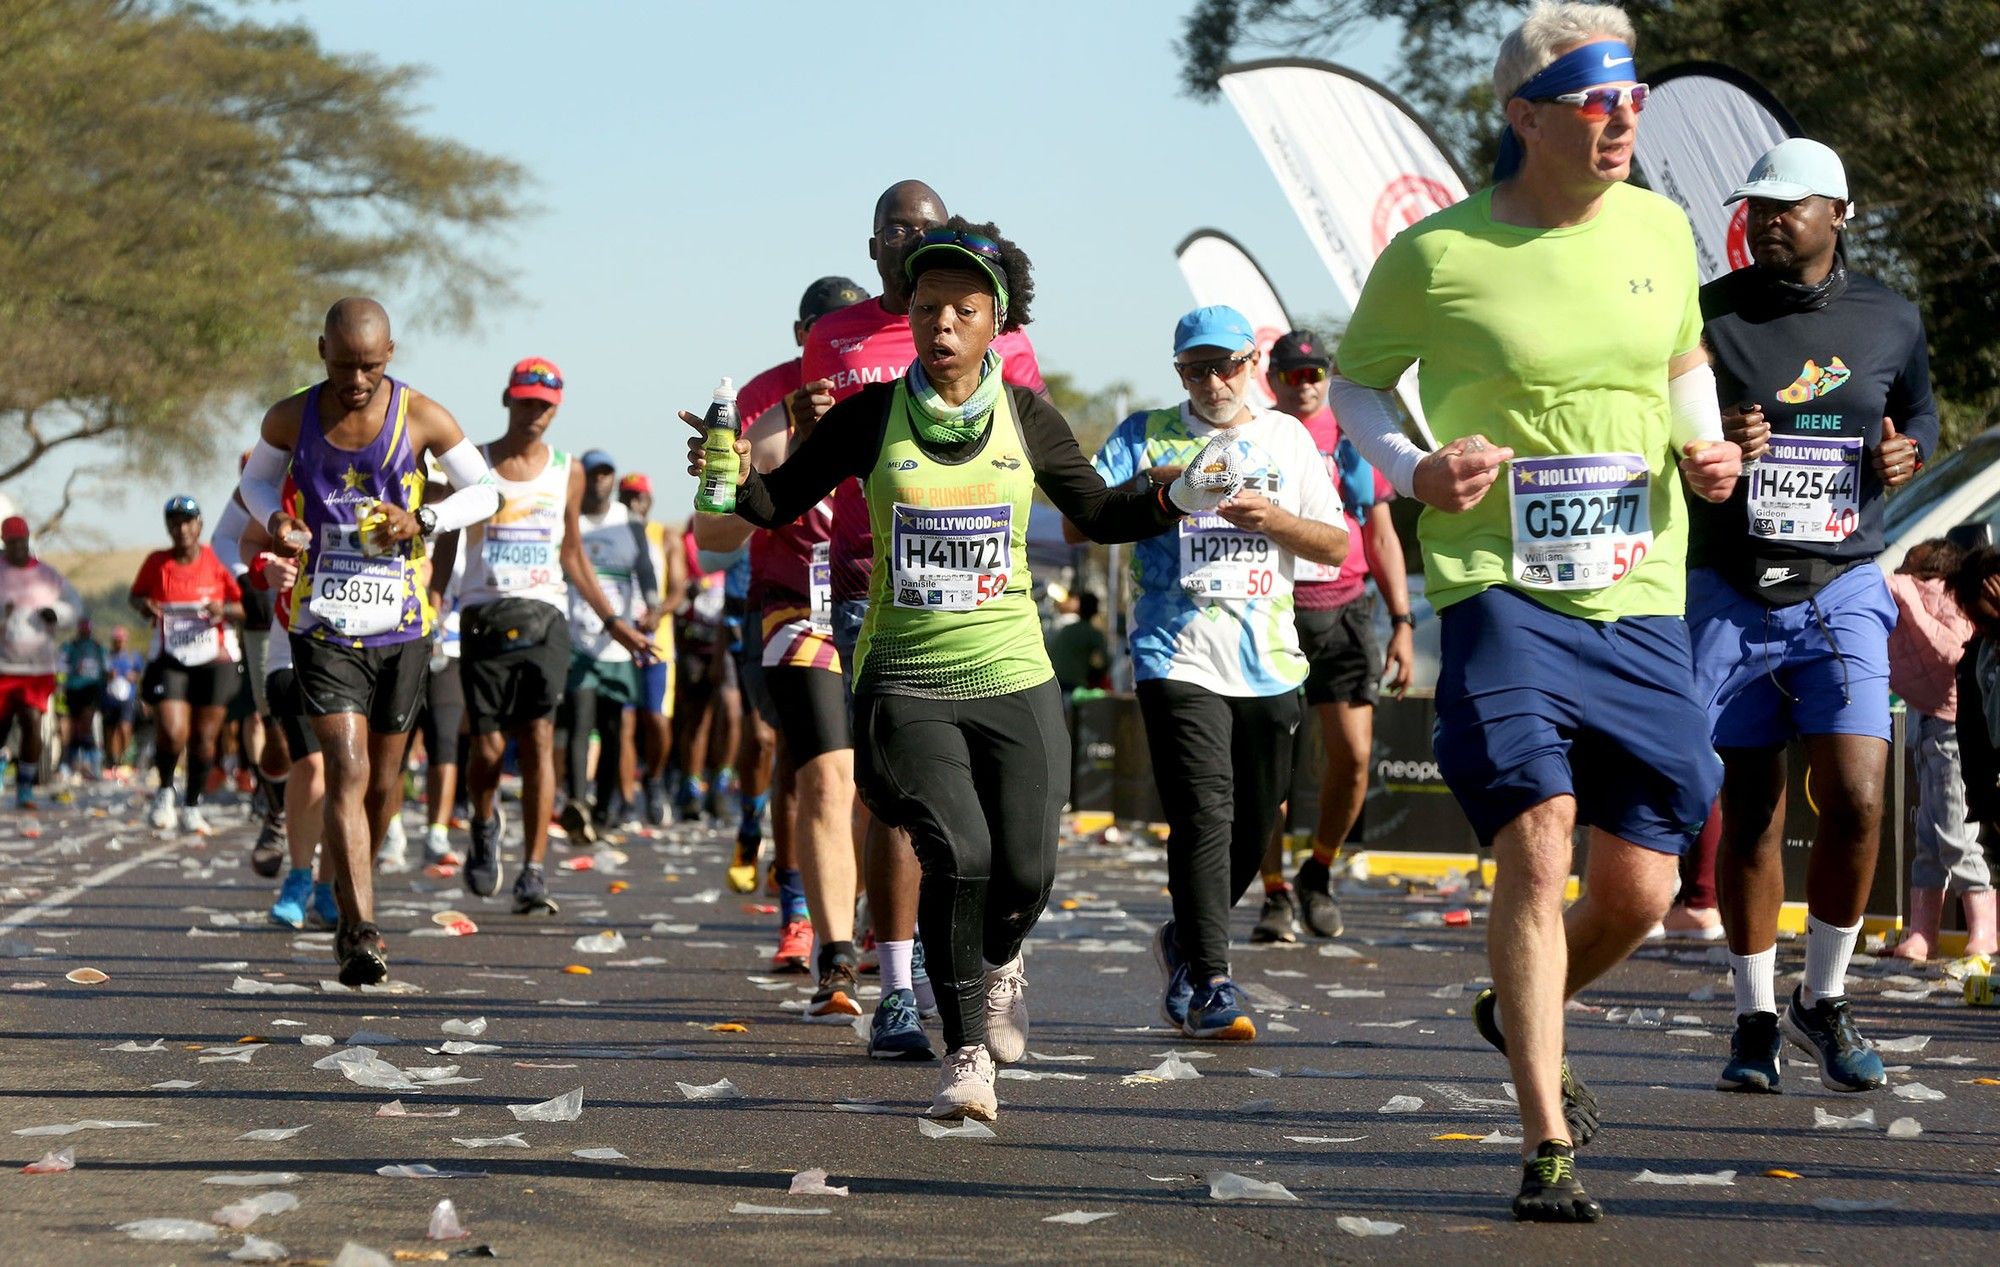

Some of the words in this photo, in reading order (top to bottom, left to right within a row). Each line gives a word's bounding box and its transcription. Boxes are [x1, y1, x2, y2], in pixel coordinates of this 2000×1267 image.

[828, 366, 882, 391] TEAM
[1795, 413, 1843, 430] IRENE
[896, 486, 925, 506] TOP
[928, 483, 997, 507] RUNNERS
[1760, 469, 1853, 500] H42544
[1525, 494, 1640, 539] G52277
[1754, 519, 1774, 530] ASA
[1756, 508, 1787, 518] Gideon
[1825, 508, 1856, 539] 40
[488, 543, 548, 565] H40819
[906, 536, 1002, 569] H41172
[1190, 536, 1269, 563] H21239
[1525, 552, 1564, 563] William
[1612, 540, 1647, 581] 50
[528, 568, 550, 589] 50
[901, 579, 937, 589] Danisile
[1247, 569, 1273, 596] 50
[1524, 565, 1551, 579] ASA
[1764, 567, 1791, 580] NIKE
[321, 577, 395, 607] G38314
[900, 589, 922, 600] ASA
[976, 573, 1008, 607] 50
